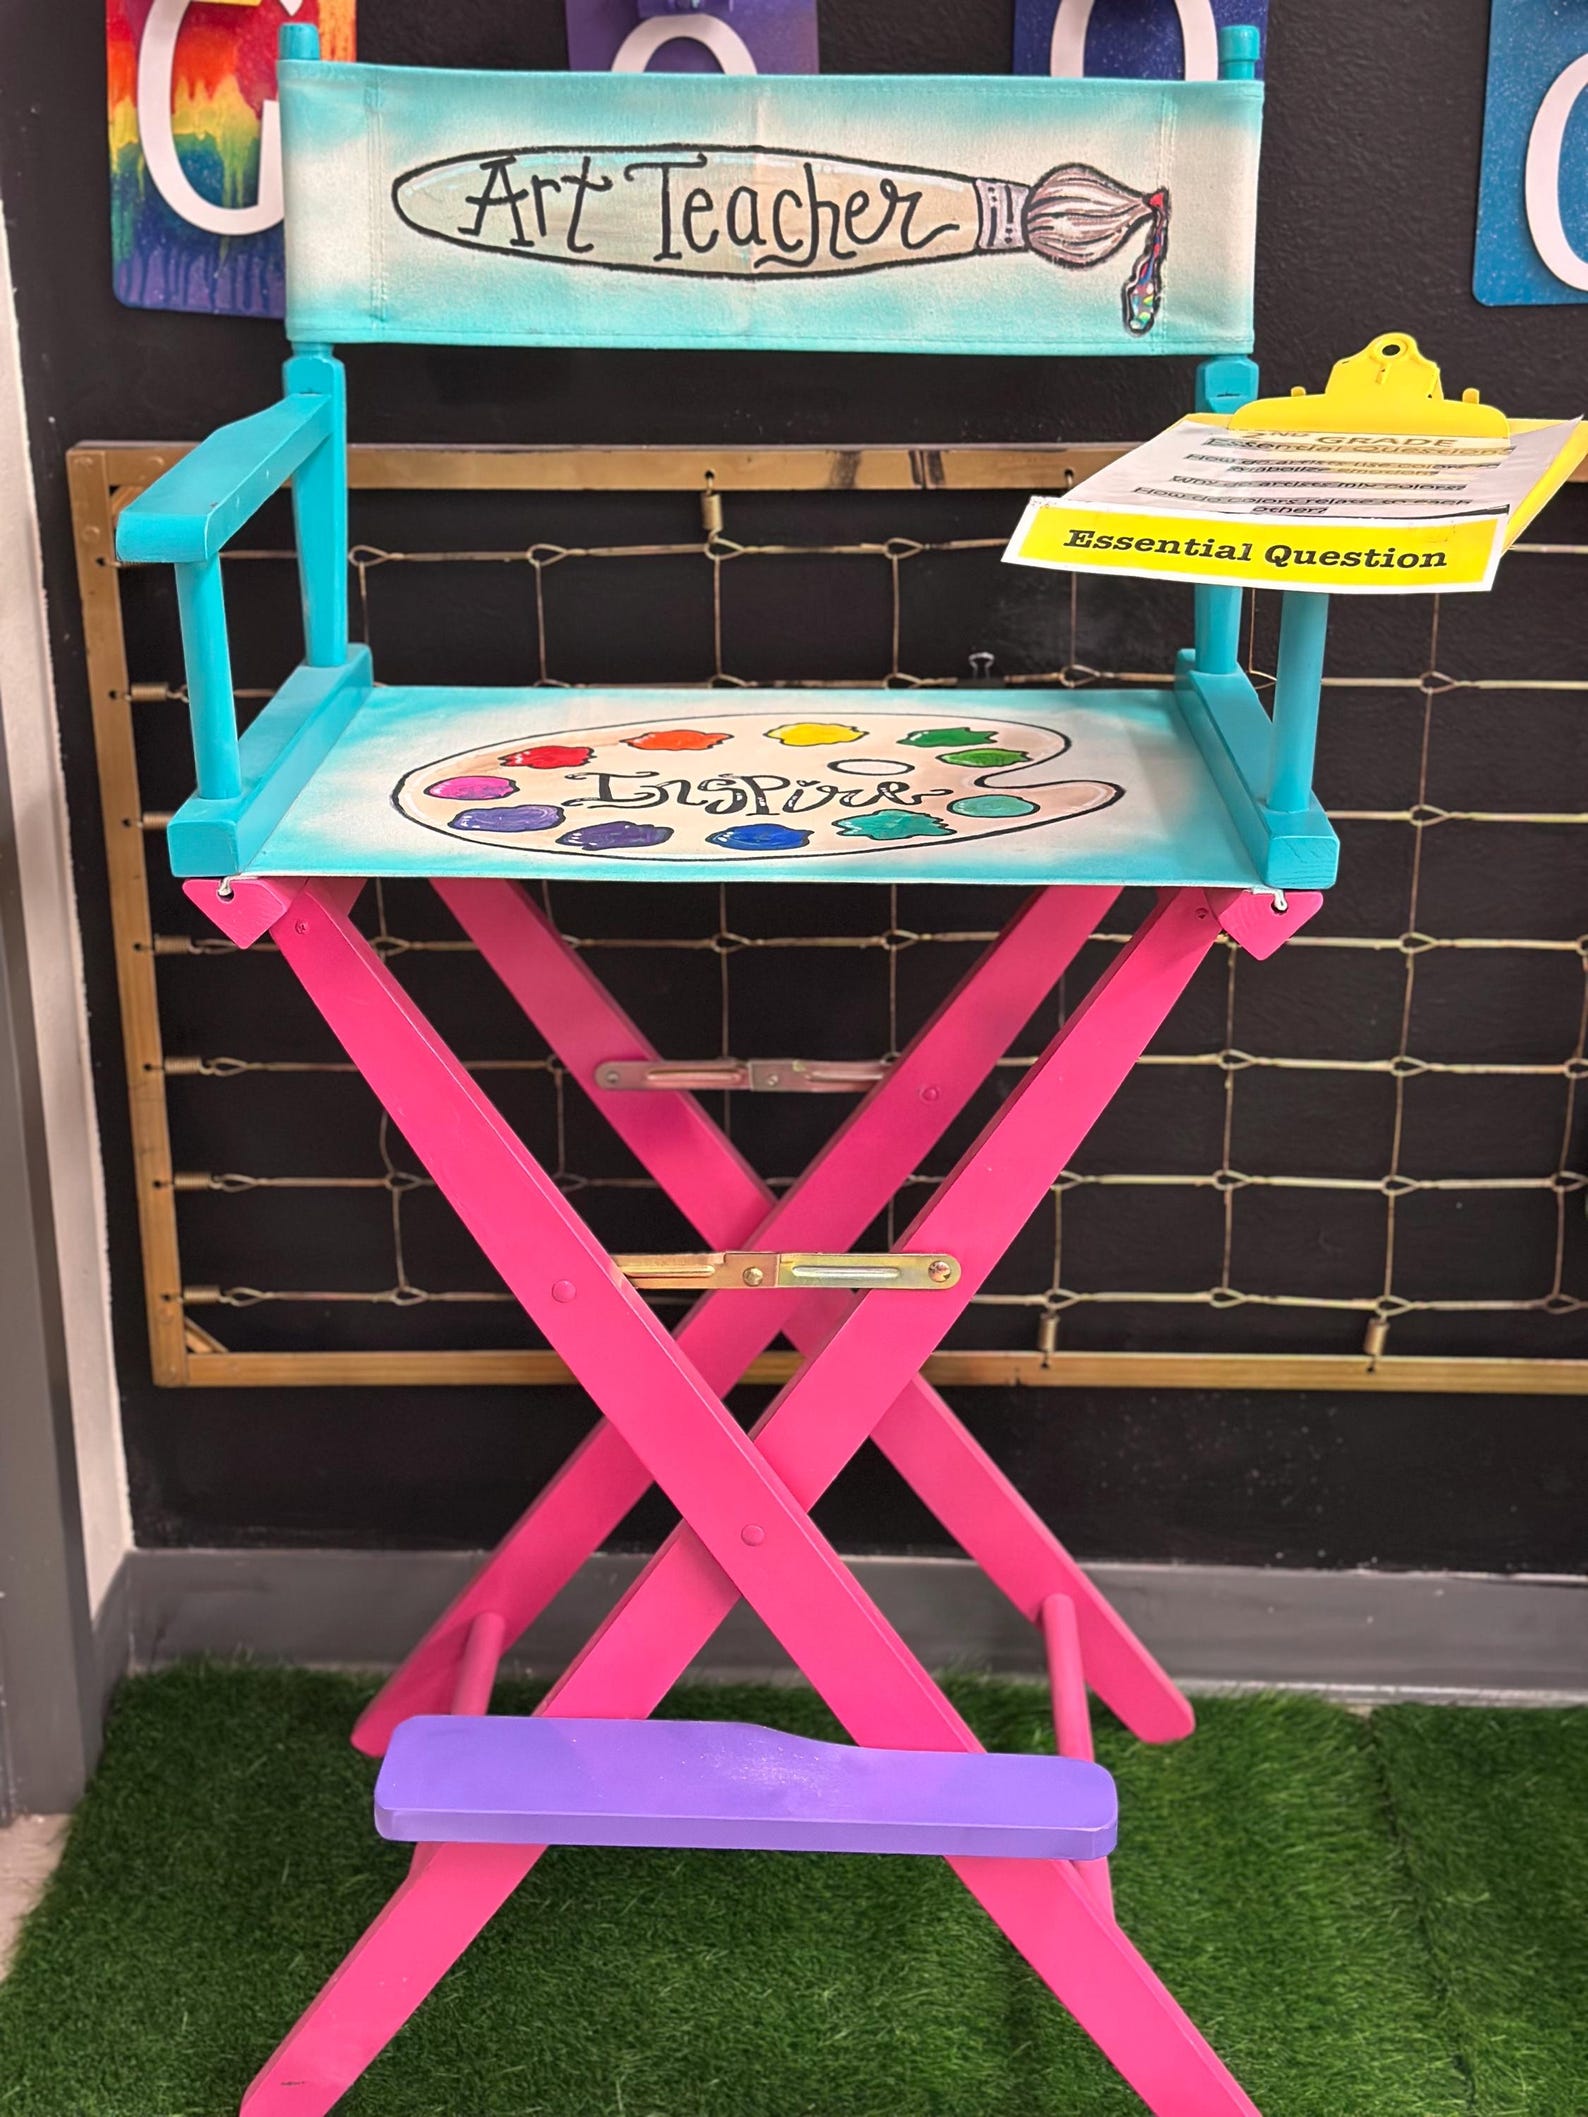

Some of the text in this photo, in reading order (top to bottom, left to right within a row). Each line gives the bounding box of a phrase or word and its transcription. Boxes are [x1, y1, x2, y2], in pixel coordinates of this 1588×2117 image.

[458, 152, 960, 268] Art Teacher
[1203, 437, 1342, 452] Essential
[1317, 435, 1456, 448] GRADE
[1185, 453, 1236, 464] How
[1171, 475, 1217, 487] Why
[1259, 480, 1332, 489] artists
[1337, 481, 1377, 490] mix
[1133, 486, 1186, 498] How
[1191, 495, 1221, 504] do
[1226, 497, 1298, 506] colors
[1303, 497, 1374, 506] relate
[1251, 505, 1328, 515] other?
[1063, 528, 1448, 569] Essential Question
